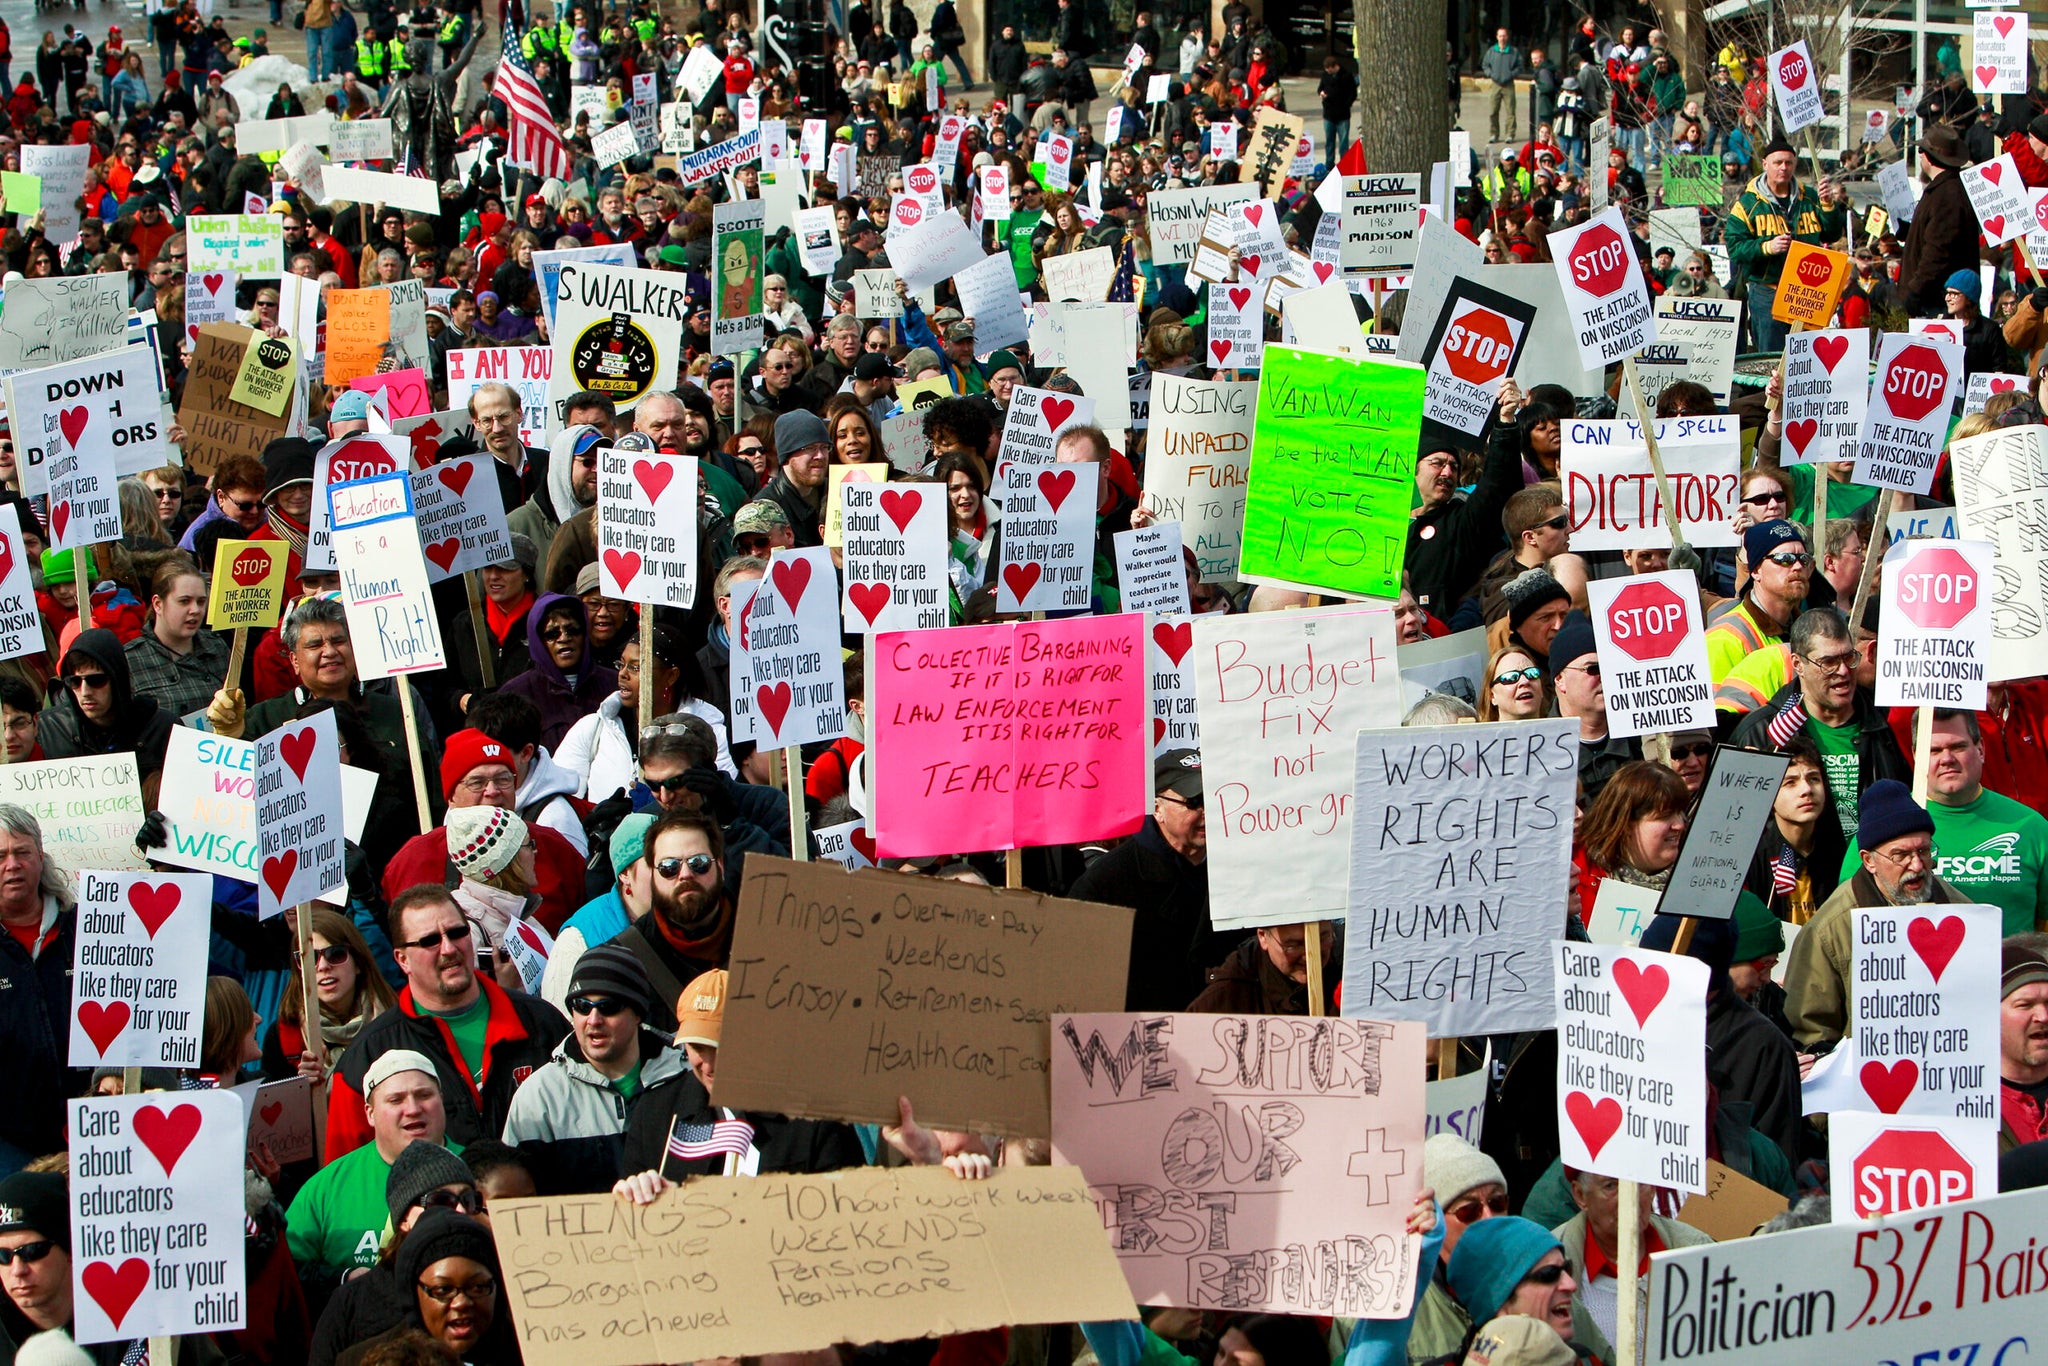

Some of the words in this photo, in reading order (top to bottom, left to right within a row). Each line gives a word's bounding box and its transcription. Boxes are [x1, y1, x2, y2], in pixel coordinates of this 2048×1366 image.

[1976, 14, 1990, 25] Care
[1976, 27, 1993, 37] about
[1976, 40, 2006, 52] educators
[1781, 60, 1804, 82] STOP
[1976, 53, 1987, 64] like
[1988, 54, 2001, 66] they
[2002, 56, 2016, 64] care
[1999, 68, 2007, 78] for
[2008, 69, 2021, 79] your
[2010, 80, 2025, 91] child
[1786, 98, 1795, 107] THE
[1796, 88, 1813, 102] ATTACK
[1786, 110, 1793, 119] ON
[1793, 96, 1819, 115] WISCONSIN
[1794, 109, 1815, 126] FAMILIES
[682, 129, 759, 171] MUBARAK-OUT!
[1051, 144, 1068, 157] STOP
[684, 144, 761, 183] WALKER-OUT!
[910, 174, 934, 187] STOP
[986, 177, 1005, 189] STOP
[1358, 178, 1405, 192] UFCW
[897, 205, 921, 218] STOP
[1370, 218, 1394, 227] 1968
[717, 217, 764, 234] SCOTT-
[1369, 245, 1393, 255] 2011
[1574, 240, 1622, 281] STOP
[1799, 260, 1830, 279] STOP
[56, 276, 103, 296] SCOTT
[1788, 284, 1799, 294] THE
[1800, 288, 1827, 301] ATTACK
[70, 290, 120, 313] WALKER
[363, 296, 379, 305] LET
[583, 278, 684, 322] WALKER
[1583, 309, 1606, 327] THE
[1607, 290, 1641, 319] ATTACK
[1672, 301, 1723, 316] UFCW
[1783, 293, 1794, 303] ON
[1795, 296, 1825, 311] WORKER
[1788, 305, 1814, 319] RIGHTS
[333, 321, 377, 331] CLOSE
[715, 321, 730, 335] He's
[733, 323, 737, 332] a
[739, 318, 763, 334] Dick
[1581, 329, 1598, 346] ON
[1599, 305, 1650, 341] WISCONSIN
[1706, 328, 1733, 340] 1473
[261, 343, 289, 366] STOP
[1601, 329, 1644, 359] FAMILIES
[248, 364, 262, 378] THE
[261, 368, 286, 385] ATTACK
[449, 353, 464, 380] I
[475, 350, 507, 379] AM
[47, 370, 124, 402] DOWN
[244, 372, 255, 385] ON
[254, 377, 282, 394] WORKER
[247, 385, 273, 401] RIGHTS
[1431, 372, 1452, 389] THE
[1454, 383, 1494, 405] ATTACK
[208, 390, 257, 421] WILL
[1162, 380, 1247, 416] USING
[1442, 395, 1488, 419] WORKER
[1429, 406, 1469, 428] RIGHTS
[191, 419, 241, 445] HURT
[1164, 429, 1248, 456] UNPAID
[1572, 424, 1611, 446] CAN
[1678, 418, 1727, 437] SPELL
[602, 452, 626, 476] Care
[1274, 435, 1301, 462] be
[1309, 442, 1340, 464] the
[1349, 443, 1416, 475] MAN
[602, 480, 632, 500] about
[1291, 485, 1376, 517] VOTE
[334, 488, 400, 522] Education
[602, 506, 656, 527] educators
[1152, 496, 1185, 521] DAY
[1197, 503, 1223, 520] TO
[354, 538, 365, 554] is
[379, 536, 388, 548] a
[602, 529, 622, 548] like
[625, 530, 647, 552] they
[650, 536, 675, 554] care
[1135, 531, 1162, 544] Maybe
[1195, 534, 1232, 551] ALL
[1132, 543, 1168, 557] Governor
[644, 555, 659, 575] for
[661, 560, 686, 579] your
[1125, 559, 1154, 571] Walker
[1155, 554, 1177, 565] would
[344, 568, 401, 597] Human
[1134, 569, 1173, 584] appreciate
[666, 581, 692, 605] child
[1129, 583, 1158, 597] teachers
[1160, 583, 1167, 592] if
[1169, 581, 1180, 591] he
[1131, 600, 1145, 611] had
[1154, 594, 1180, 608] college
[374, 591, 441, 667] Right!
[1613, 604, 1683, 640] STOP
[892, 642, 1012, 671] COLLECTIVE
[1021, 632, 1133, 663] BARGAINING
[1214, 636, 1387, 706] Budget
[1616, 672, 1644, 689] THE
[1645, 664, 1696, 686] ATTACK
[1610, 694, 1631, 711] ON
[1632, 684, 1709, 708] WISCONSIN
[893, 704, 944, 726] LAW
[954, 699, 1121, 720] ENFORCEMENT
[1260, 695, 1333, 739] Fix
[1632, 707, 1693, 730] FAMILIES
[1273, 744, 1326, 778] not
[1381, 732, 1575, 786] WORKERS
[14, 766, 93, 791] SUPPORT
[923, 760, 1101, 797] TEACHERS
[1720, 770, 1775, 791] WHERE
[1379, 795, 1558, 850] RIGHTS
[1709, 831, 1734, 846] THE
[1435, 845, 1517, 890] ARE
[1691, 856, 1738, 871] NATIONAL
[1954, 874, 1989, 883] America
[1992, 874, 2021, 884] Happen
[1369, 896, 1505, 950] HUMAN
[1369, 950, 1528, 1006] RIGHTS
[1059, 1015, 1179, 1096] WE
[1196, 1016, 1395, 1096] SUPPORT
[78, 1105, 120, 1138] Care
[1161, 1101, 1305, 1190] OUR
[78, 1146, 133, 1178] about
[79, 1185, 173, 1218] educators
[80, 1225, 116, 1258] like
[120, 1225, 162, 1257] they
[166, 1221, 208, 1250] care
[154, 1259, 184, 1290] for
[186, 1259, 227, 1292] your
[194, 1291, 239, 1326] child
[1659, 1256, 1836, 1362] Politician
